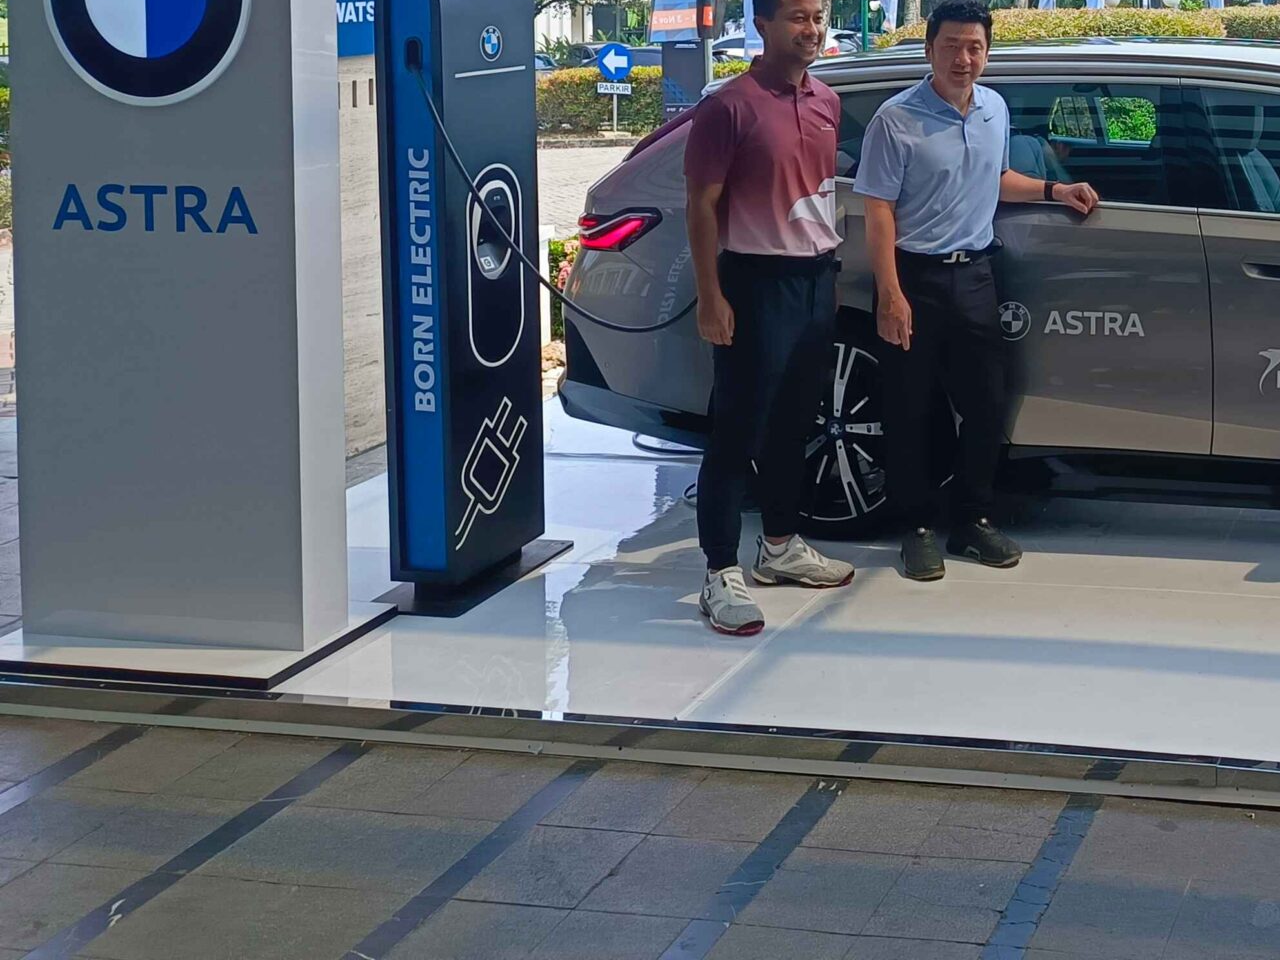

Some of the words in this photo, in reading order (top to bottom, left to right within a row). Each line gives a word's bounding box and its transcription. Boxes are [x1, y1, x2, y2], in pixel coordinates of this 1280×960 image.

[599, 83, 630, 93] PARKIR
[52, 183, 259, 235] ASTRA
[408, 146, 433, 306] ELECTRIC
[1044, 310, 1145, 337] ASTRA
[412, 316, 437, 413] BORN
